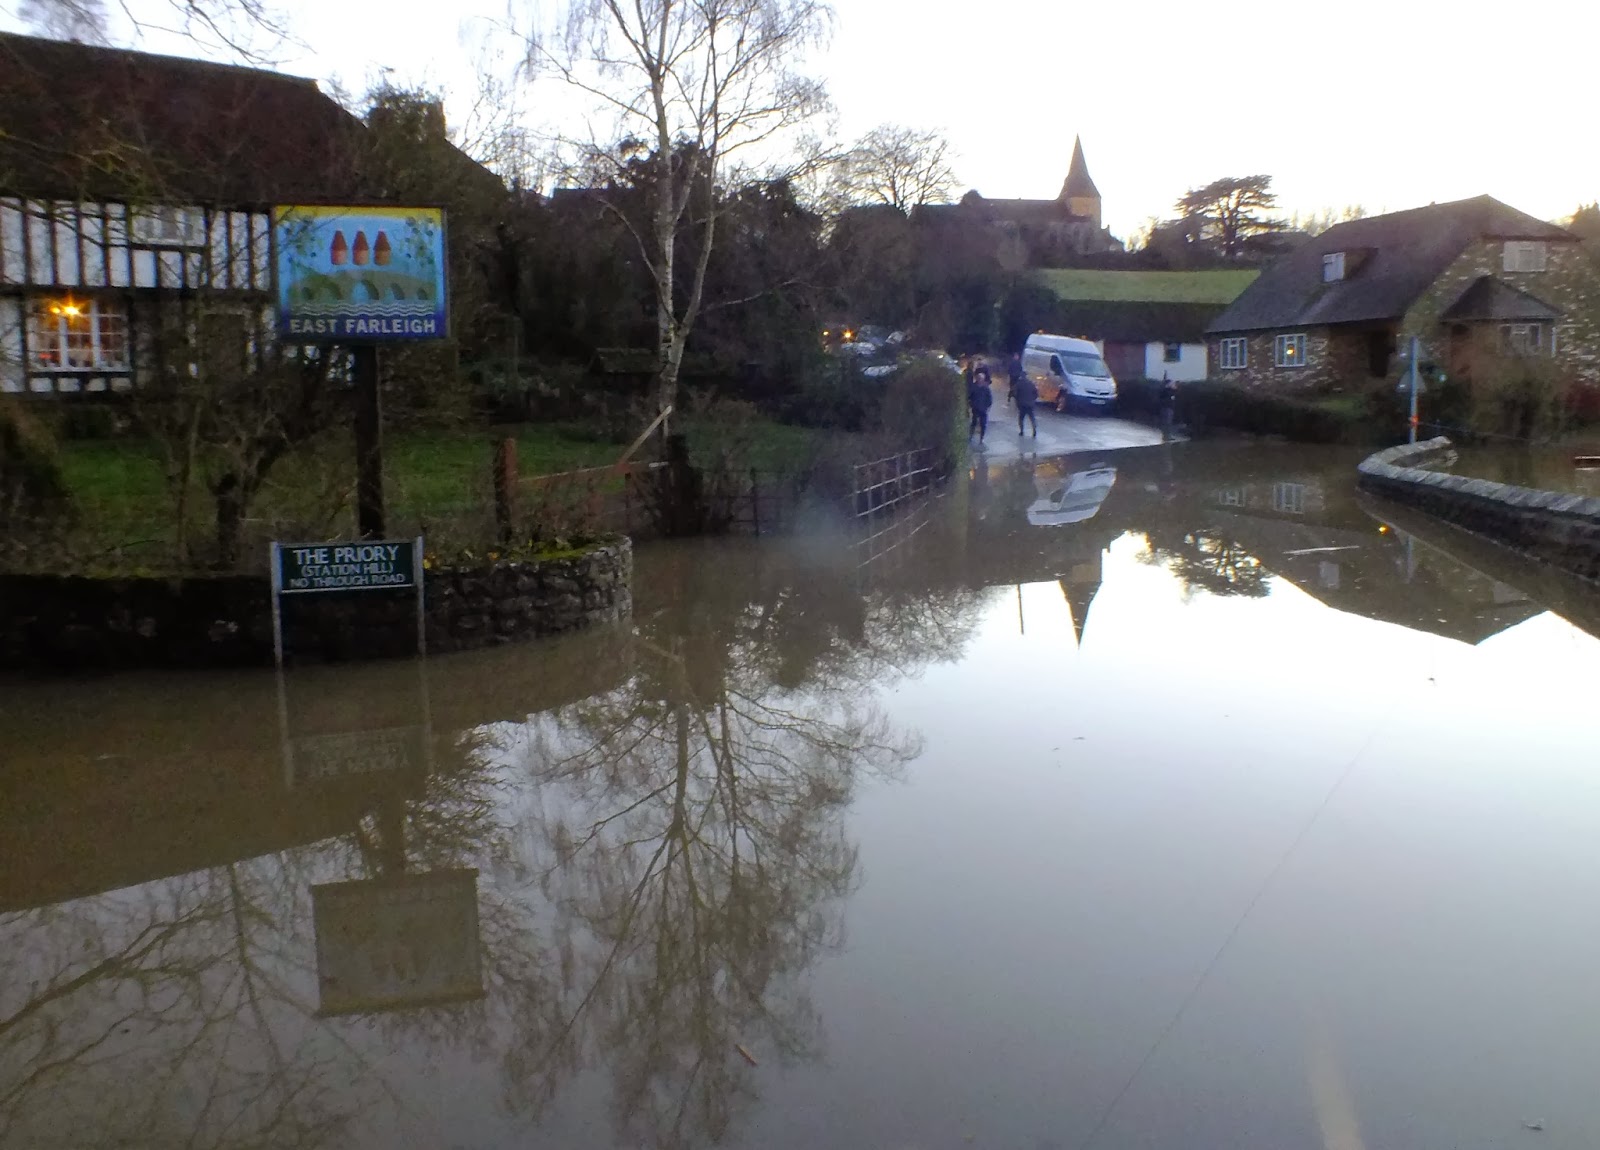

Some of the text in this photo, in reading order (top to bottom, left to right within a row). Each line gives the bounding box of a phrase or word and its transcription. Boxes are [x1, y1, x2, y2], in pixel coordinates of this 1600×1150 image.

[290, 319, 435, 333] EAST FARLEIGH
[293, 546, 399, 564] THE PRIORY
[301, 562, 393, 577] (STATION HILL)
[290, 573, 405, 588] NO THROUGH ROAD
